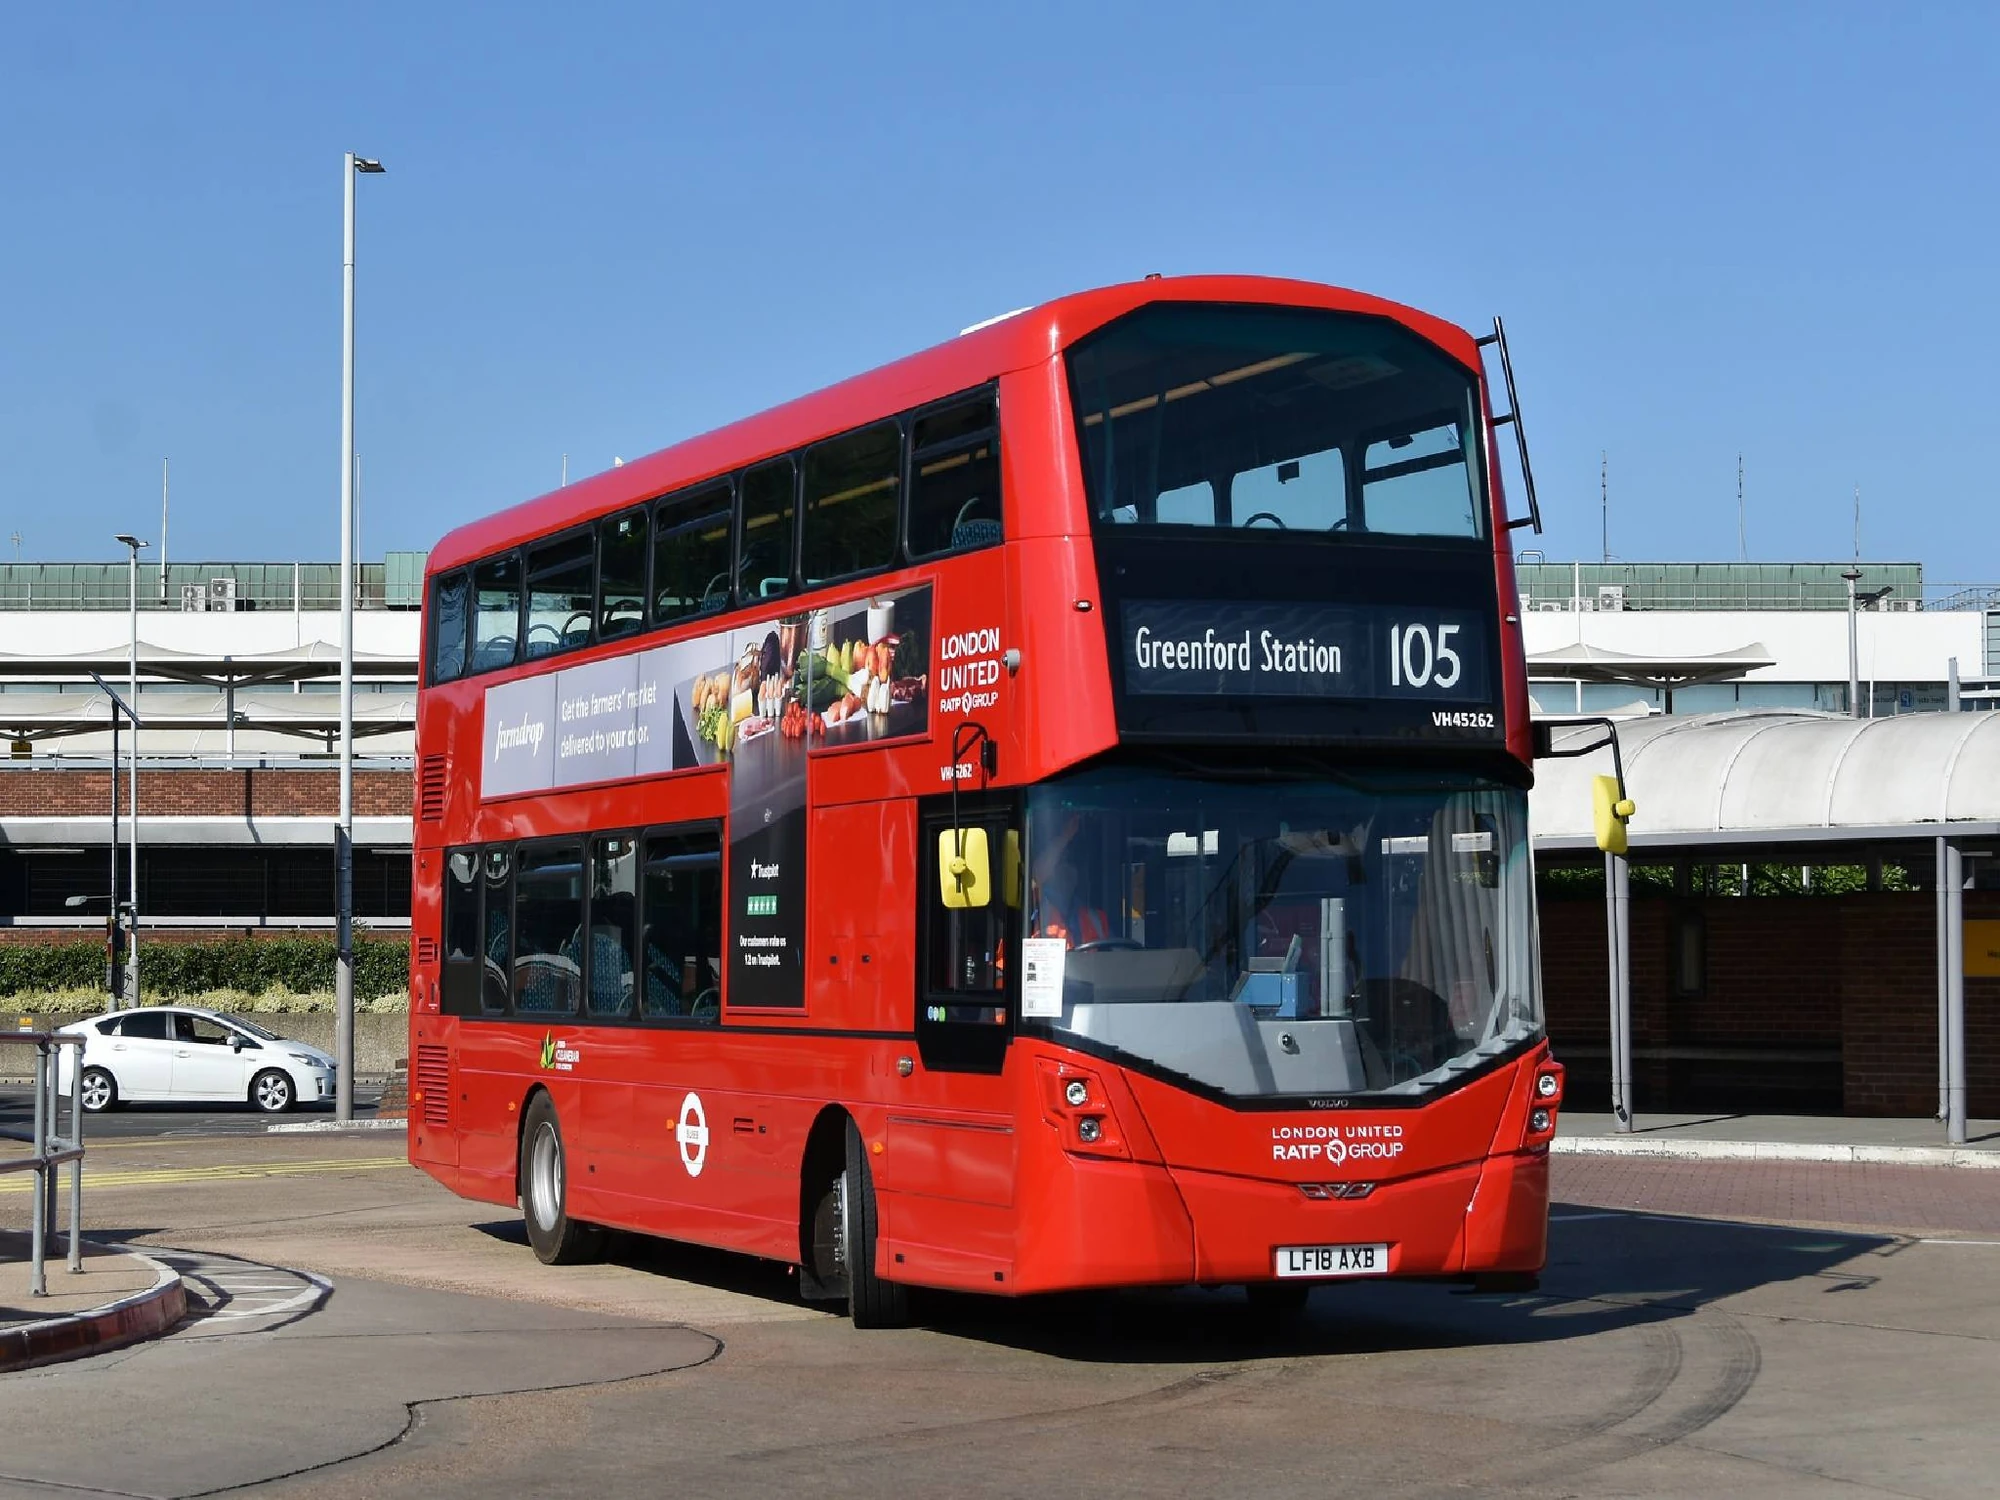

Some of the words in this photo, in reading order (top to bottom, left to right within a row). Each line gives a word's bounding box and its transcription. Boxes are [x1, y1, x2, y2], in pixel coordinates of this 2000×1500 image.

[941, 628, 1000, 661] LONDON
[1135, 625, 1250, 671] Greenford
[1260, 630, 1342, 673] Station
[1390, 622, 1461, 688] 105
[940, 659, 999, 692] UNITED
[562, 701, 575, 721] Get
[575, 698, 589, 719] the
[940, 699, 961, 713] RATP
[973, 692, 998, 708] GROUP
[1432, 711, 1494, 728] VH45262
[494, 712, 545, 763] farmdrop
[560, 732, 595, 758] delivered
[595, 732, 605, 751] to
[606, 730, 626, 756] your
[1308, 1100, 1349, 1108] VOLVO
[1272, 1127, 1339, 1139] LONDON
[1345, 1126, 1403, 1138] UNITED
[1273, 1145, 1321, 1160] RATP
[1349, 1142, 1404, 1158] GROUP
[1289, 1250, 1333, 1271] LF18
[1339, 1248, 1375, 1269] AXB
